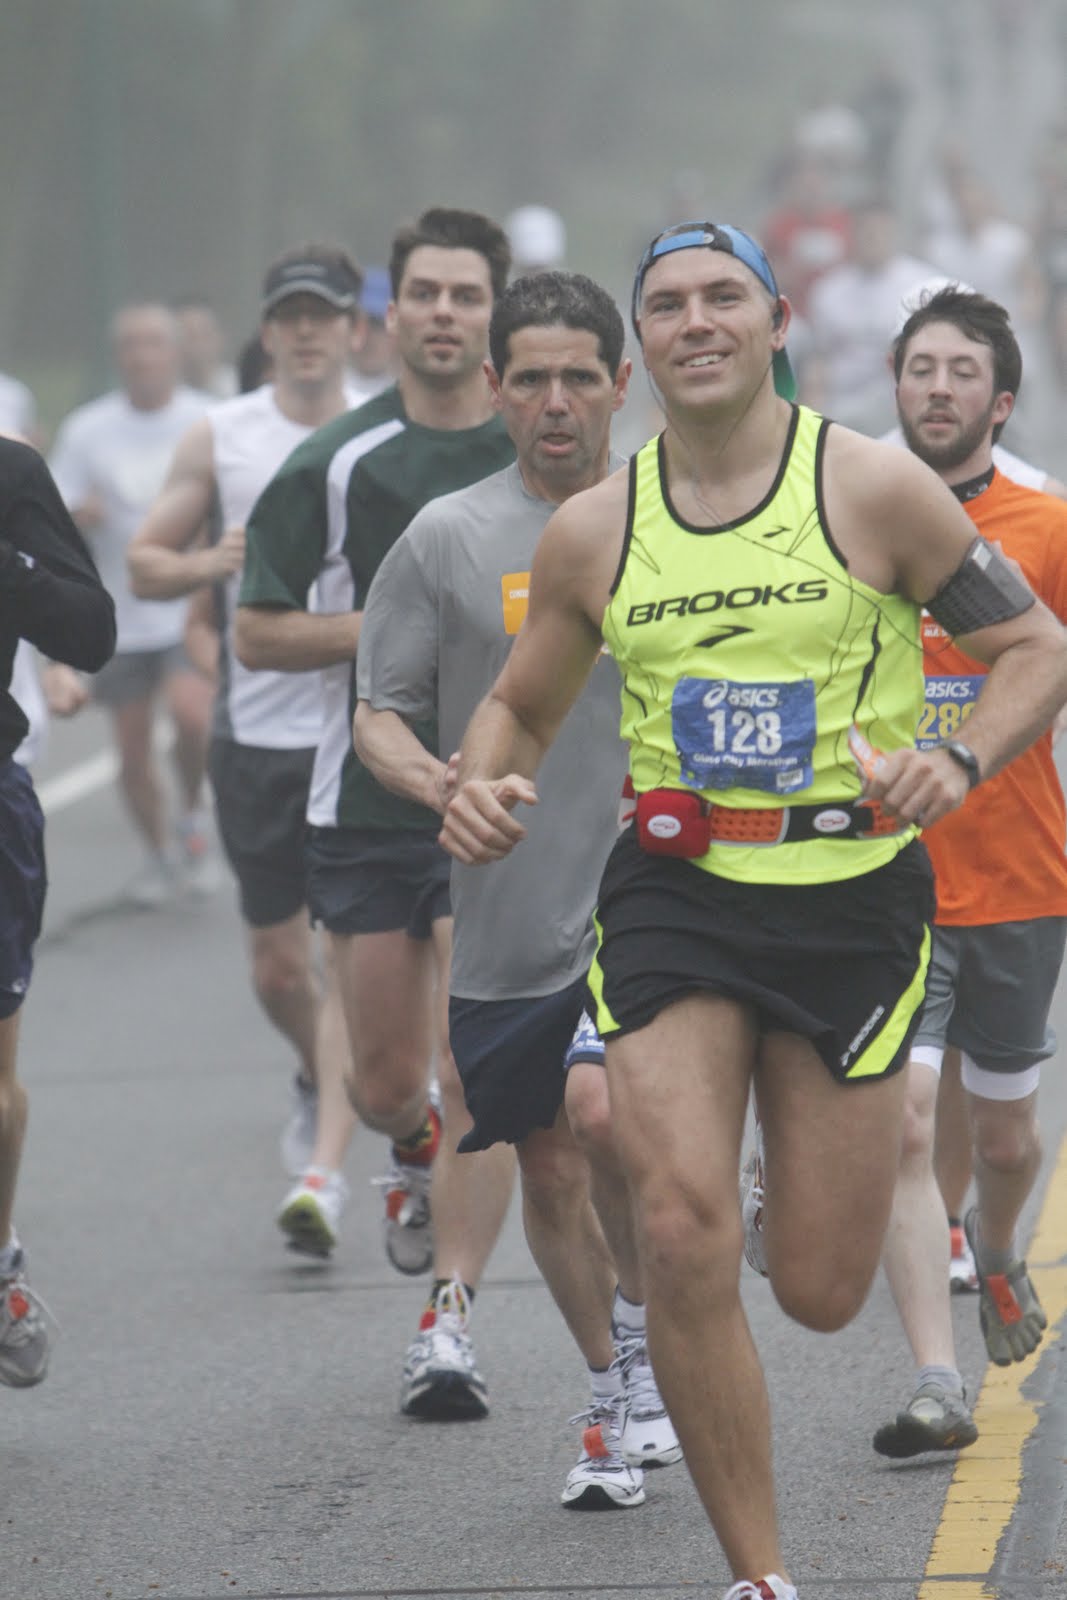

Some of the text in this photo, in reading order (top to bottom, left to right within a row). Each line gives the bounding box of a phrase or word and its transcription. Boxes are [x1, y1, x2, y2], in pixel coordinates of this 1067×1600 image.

[627, 579, 828, 627] BROOKS
[707, 709, 783, 755] 128
[722, 754, 745, 768] City
